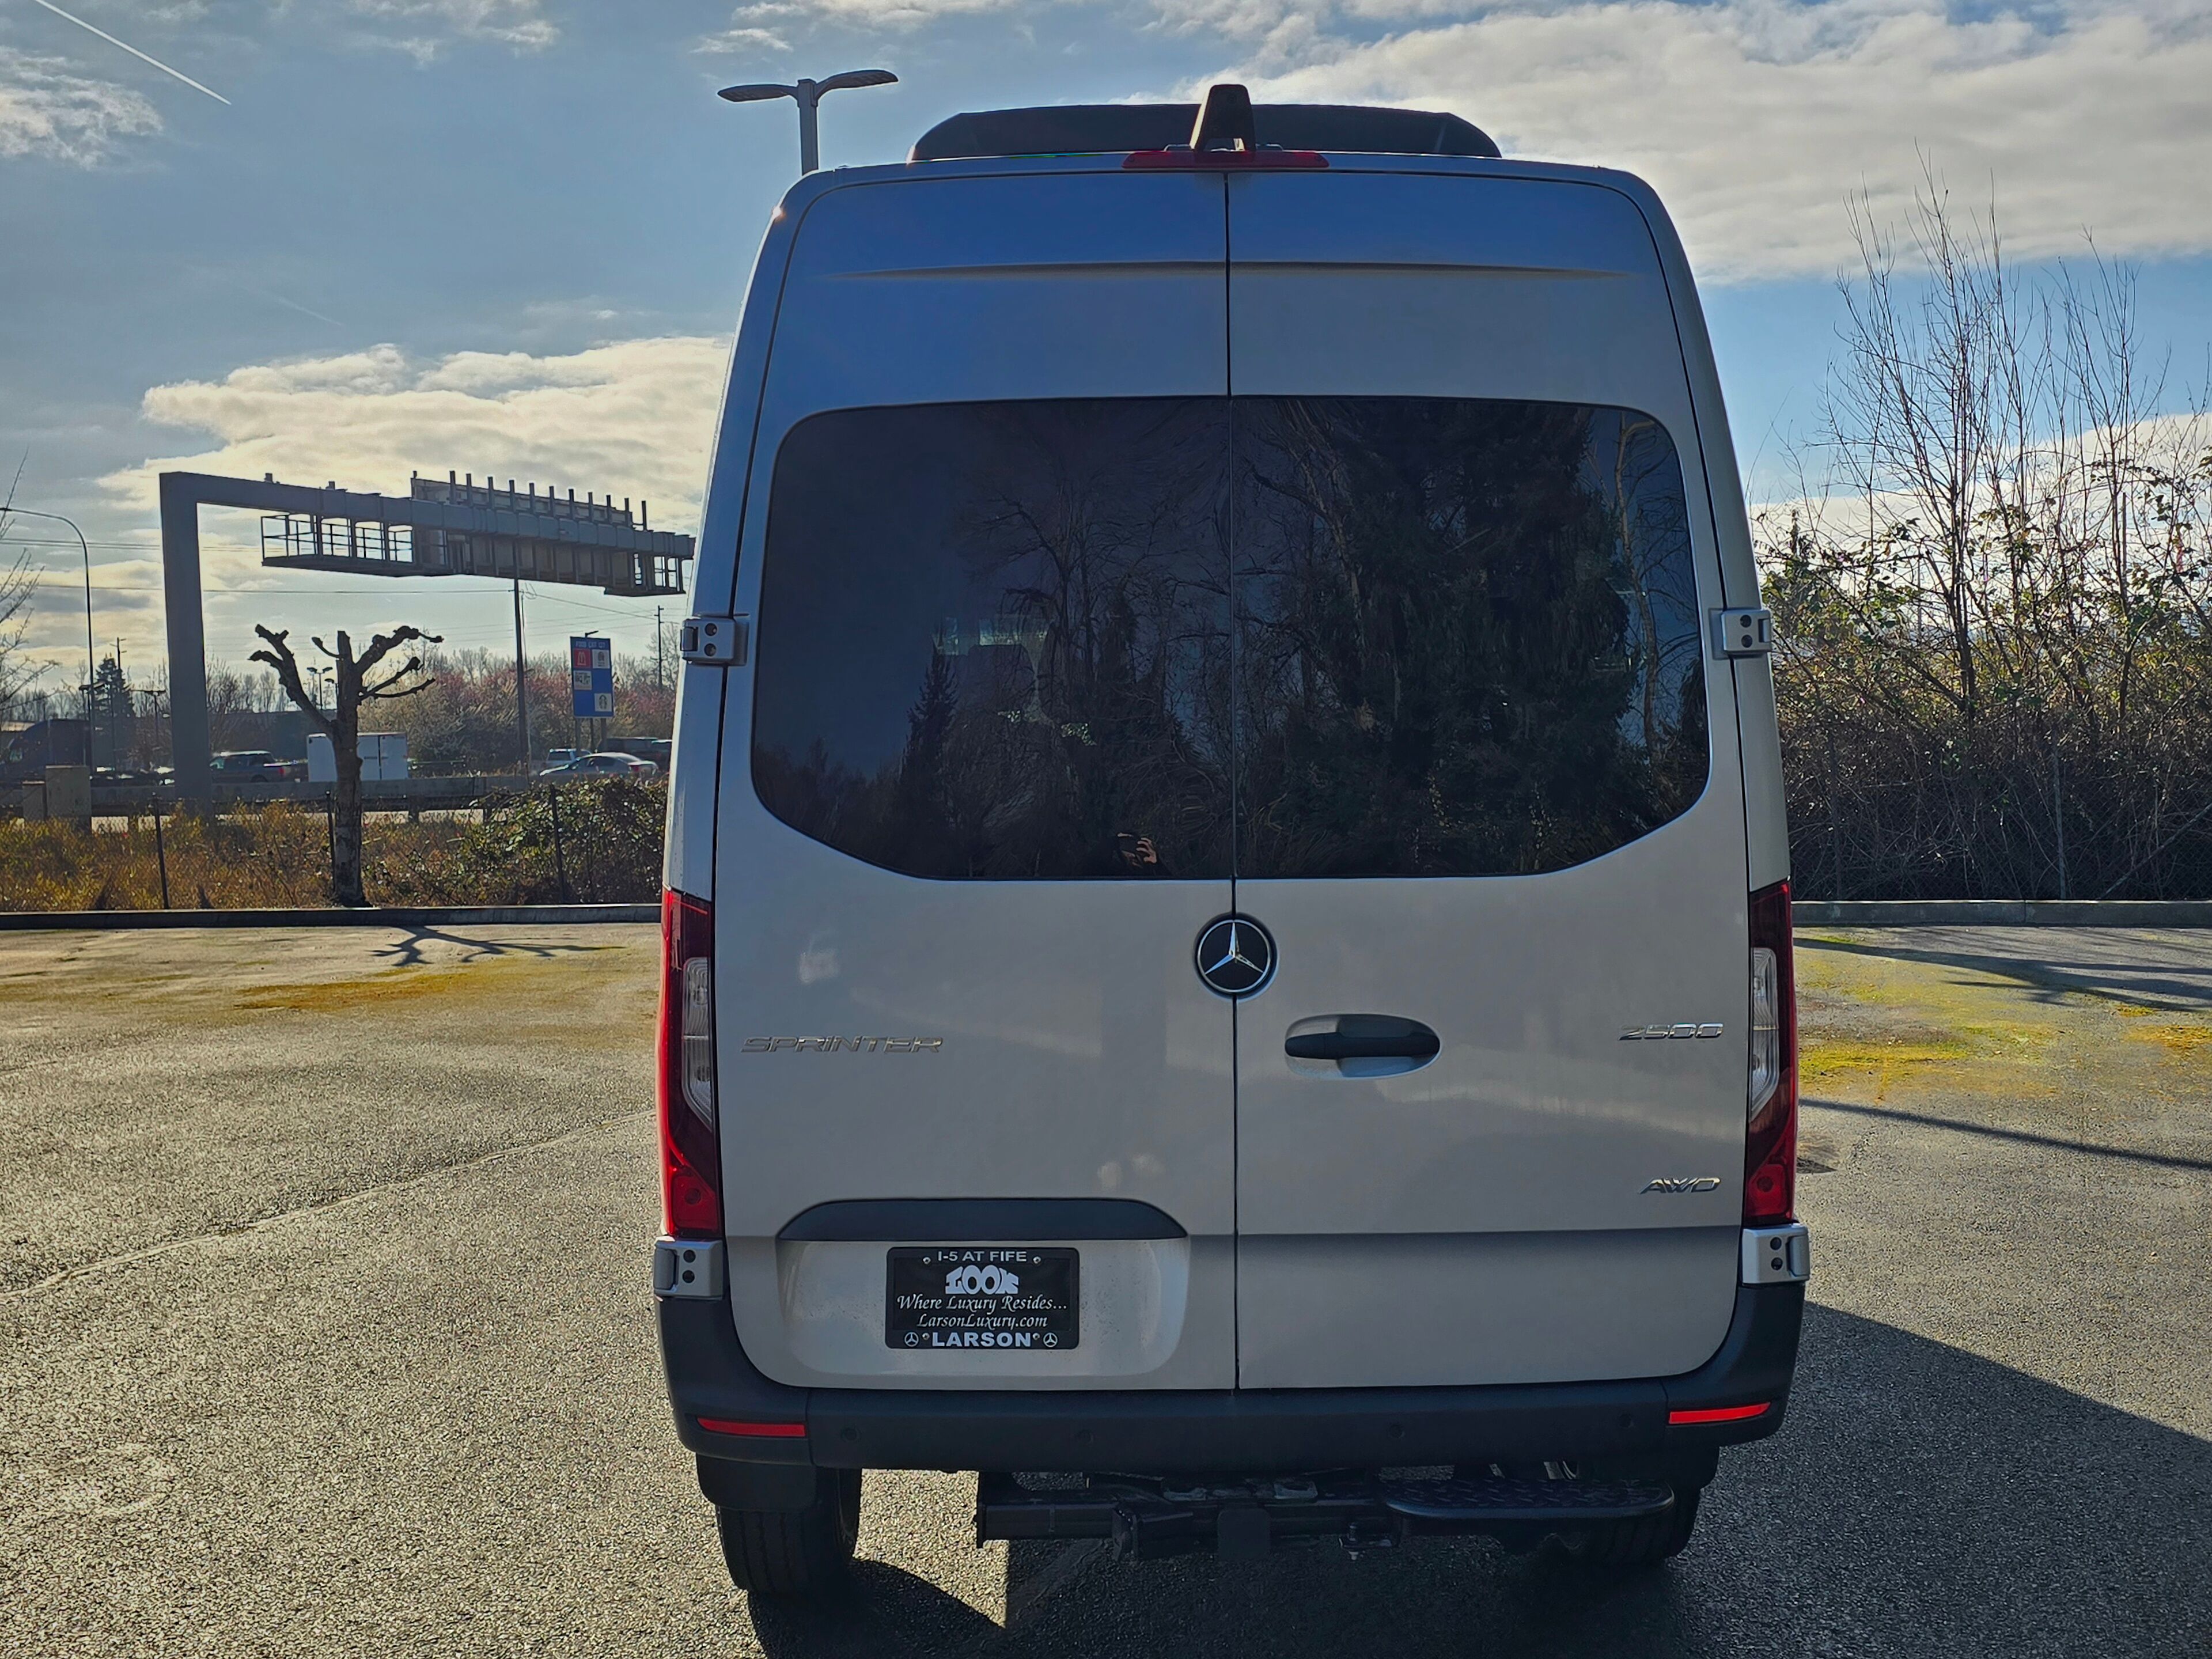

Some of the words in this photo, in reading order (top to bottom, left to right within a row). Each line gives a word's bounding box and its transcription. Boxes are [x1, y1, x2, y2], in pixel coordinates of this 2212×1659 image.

[1618, 1022, 1724, 1041] 2500
[740, 1035, 944, 1054] SPRINTER
[1638, 1177, 1721, 1195] AWD
[938, 1251, 959, 1262] I-5
[963, 1251, 985, 1262] AT
[990, 1251, 1028, 1262] FIFE
[897, 1294, 942, 1310] Where
[946, 1296, 997, 1314] Luxury
[1001, 1294, 1067, 1310] Resides...
[916, 1313, 1048, 1331] LarsonLuxury.com
[931, 1332, 1031, 1347] LARSON
